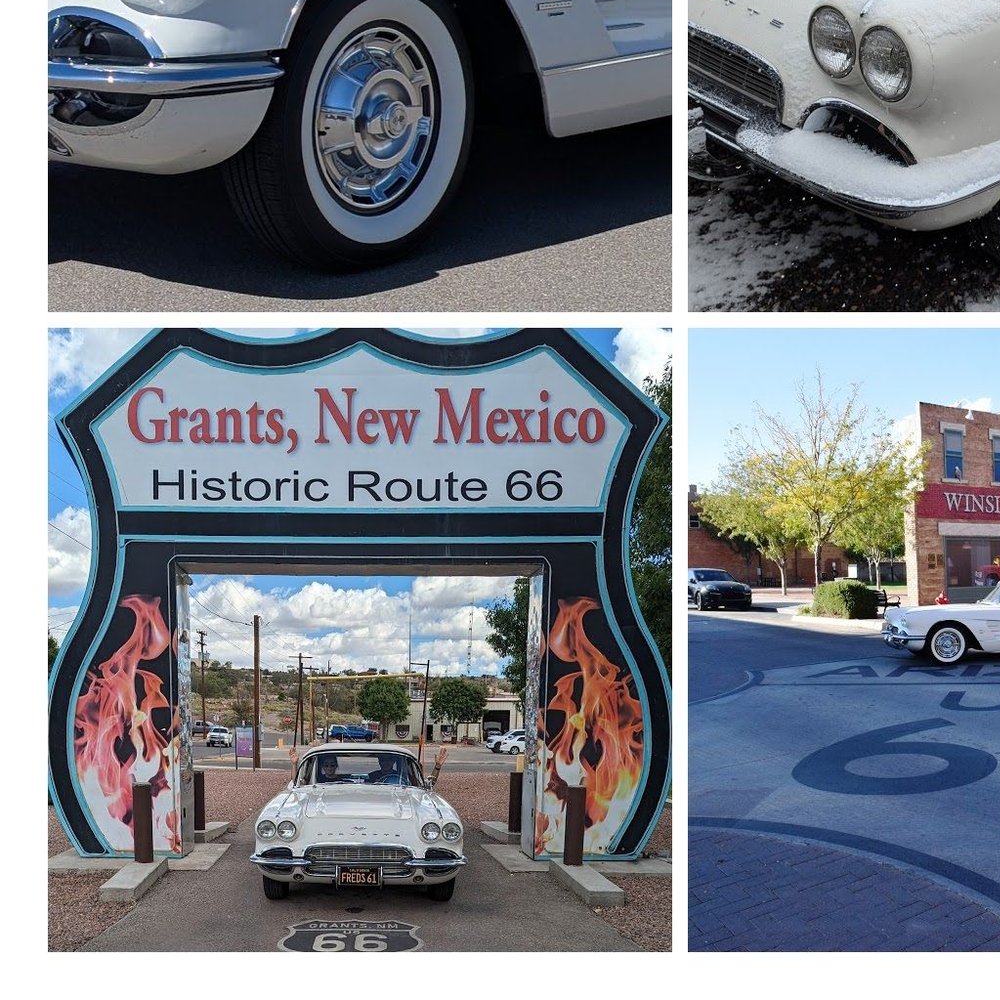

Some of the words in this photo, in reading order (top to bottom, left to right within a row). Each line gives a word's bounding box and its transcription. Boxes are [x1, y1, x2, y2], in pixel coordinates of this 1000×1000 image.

[127, 386, 298, 454] Grants,
[314, 387, 421, 445] New
[433, 387, 606, 444] Mexico
[151, 469, 330, 502] Historic
[348, 470, 488, 502] Route
[506, 469, 563, 502] 66
[341, 872, 366, 883] FREDS
[367, 873, 377, 884] 61
[312, 933, 388, 952] 66
